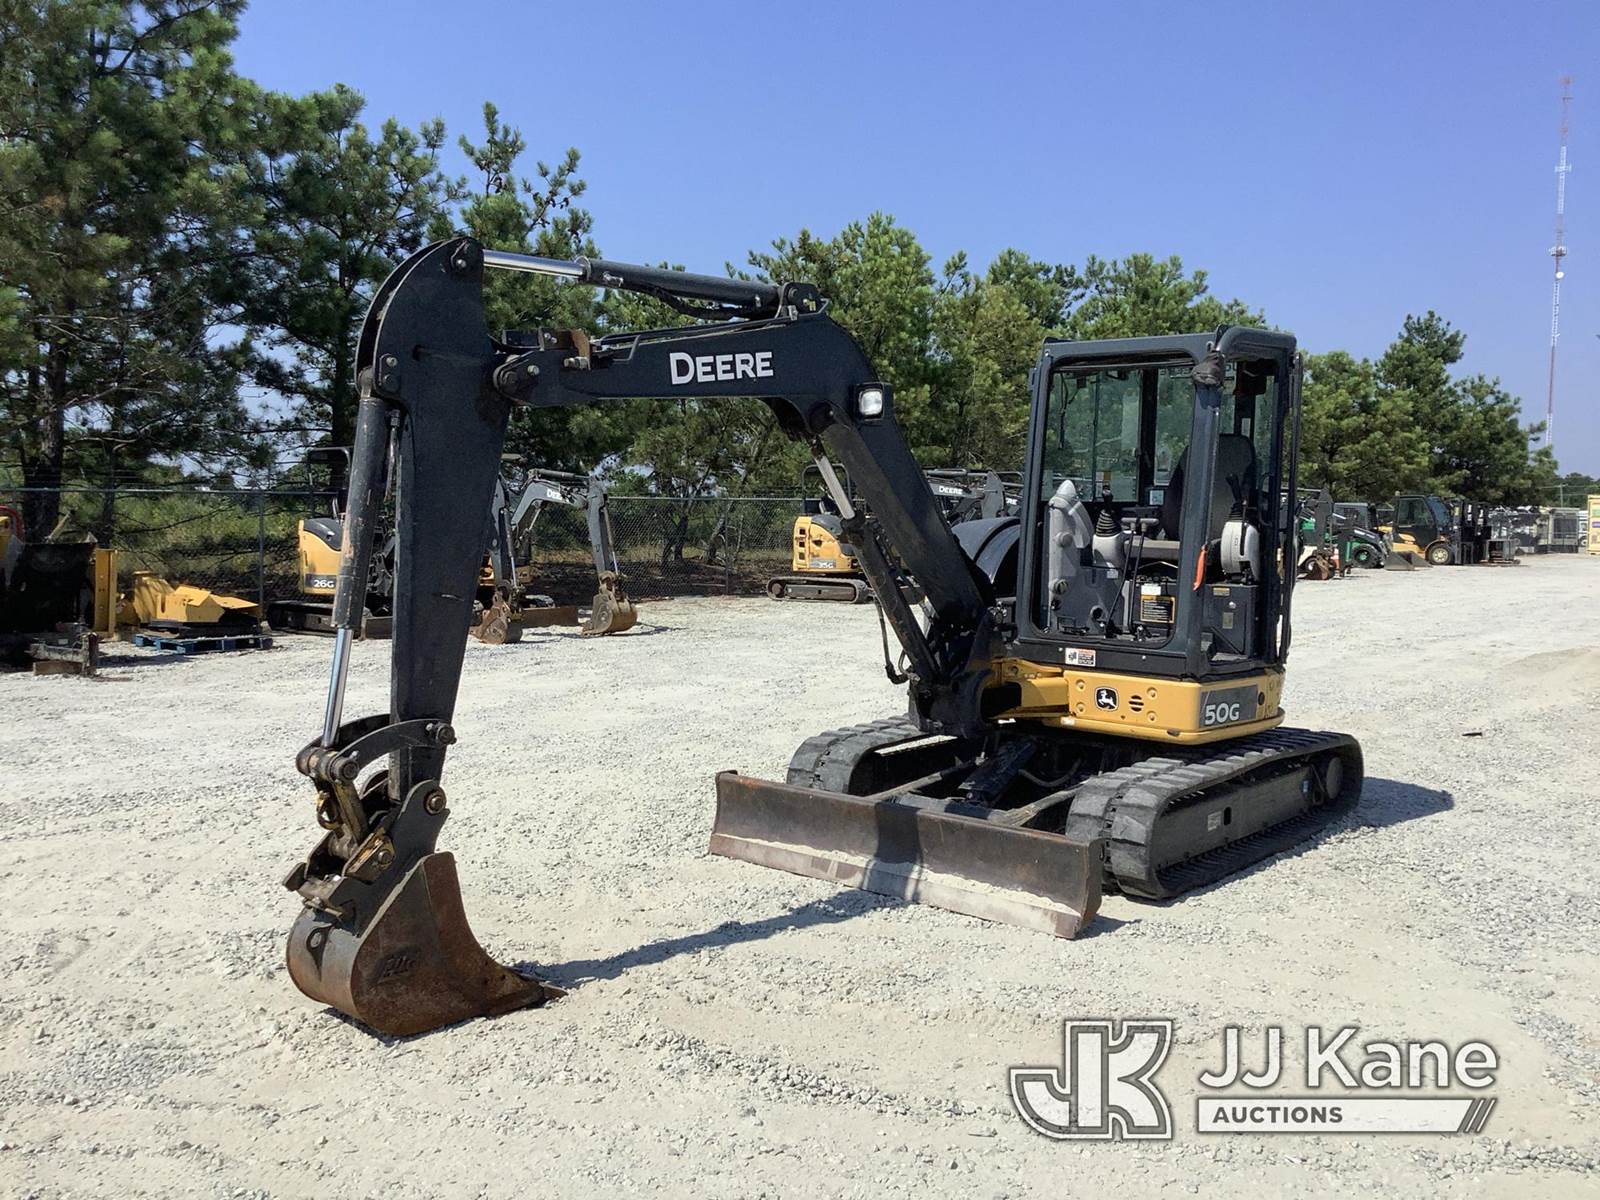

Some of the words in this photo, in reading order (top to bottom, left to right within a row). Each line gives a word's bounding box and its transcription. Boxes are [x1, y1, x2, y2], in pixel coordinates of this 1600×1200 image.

[669, 351, 774, 385] DEERE
[938, 485, 963, 496] DEERE
[313, 579, 335, 588] 26G
[1204, 702, 1240, 725] 50G
